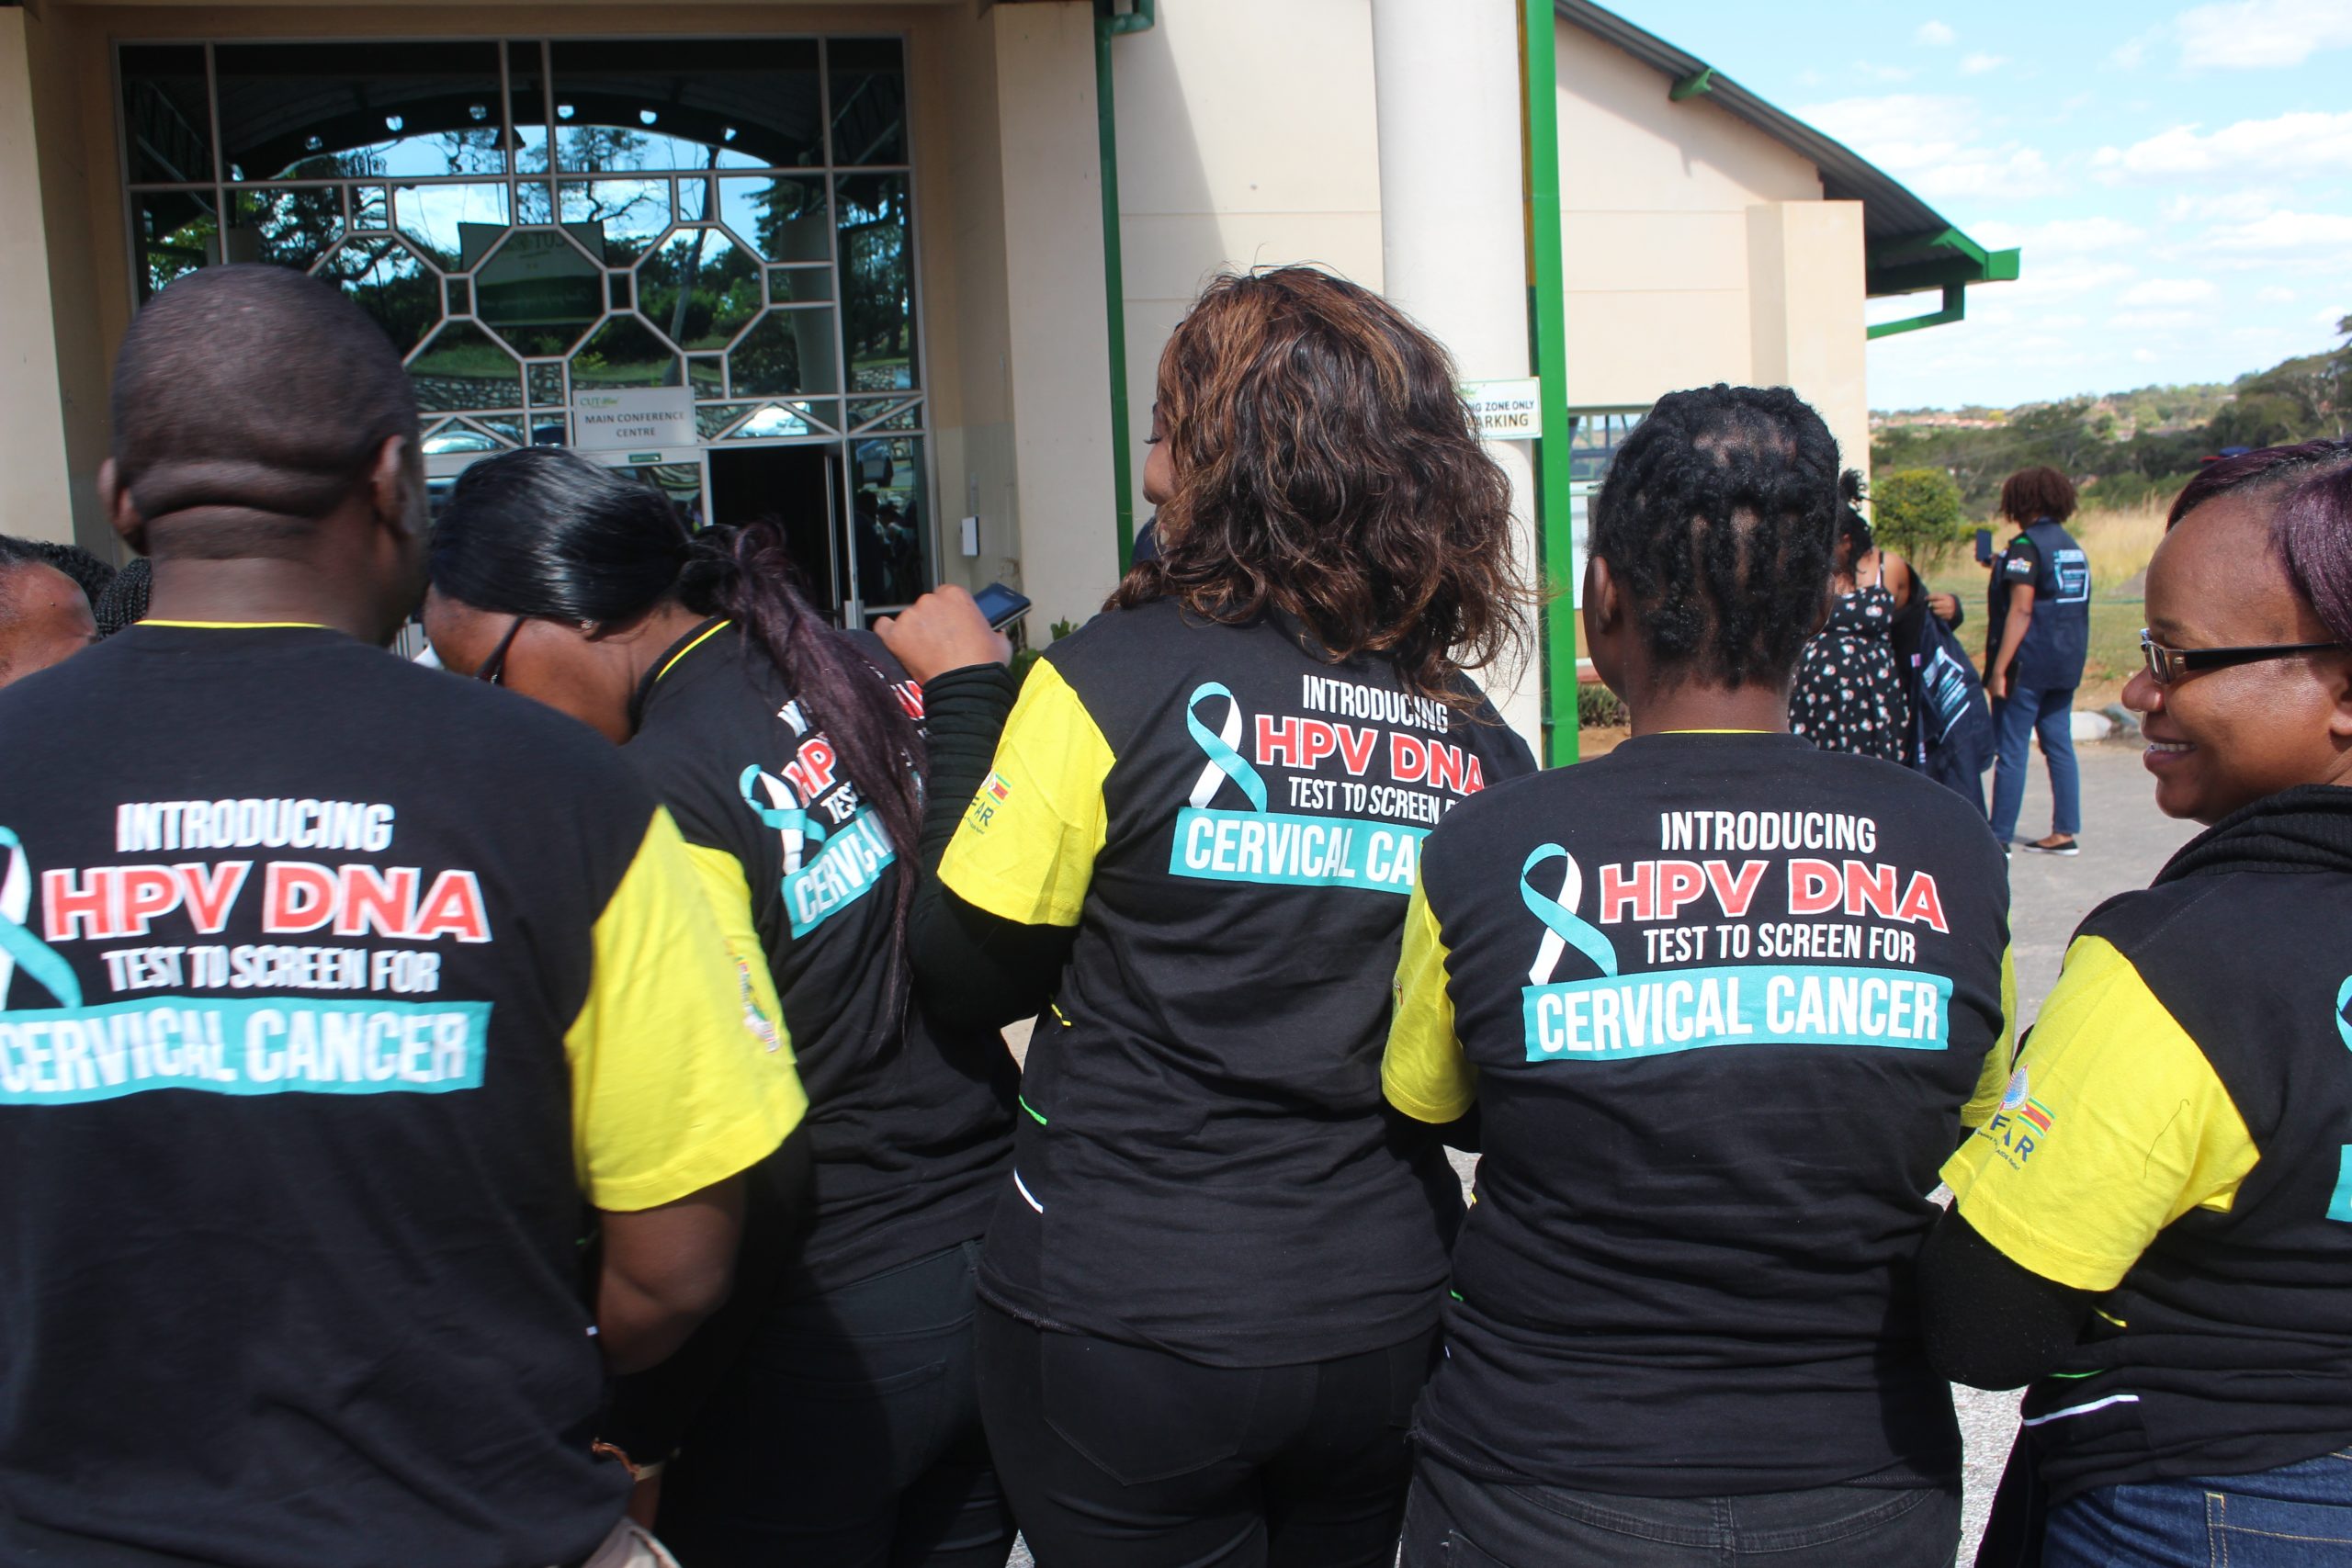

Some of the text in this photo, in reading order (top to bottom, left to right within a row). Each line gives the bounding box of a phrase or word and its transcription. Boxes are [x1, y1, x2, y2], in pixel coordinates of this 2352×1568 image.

[585, 412, 684, 423] MAIN CONFERENCE
[616, 427, 655, 437] CENTRE
[1468, 413, 1529, 428] ARKING
[1485, 401, 1510, 412] ZONE
[1512, 400, 1534, 410] ONLY
[1303, 674, 1449, 734] INTRODUCING
[781, 732, 837, 809] HP
[1255, 714, 1485, 796] HPV DNA
[116, 797, 395, 853] INTRODUCING
[820, 781, 858, 824] TES
[1288, 776, 1337, 810] TEST
[1341, 782, 1371, 813] TO
[1372, 785, 1440, 825] SCREEN
[1185, 817, 1355, 878] CERVICAL
[1661, 811, 1877, 853] INTRODUCING
[41, 859, 492, 943] HPV DNA
[1600, 858, 1950, 934] HPV DNA
[101, 943, 442, 993] TEST TO SCREEN FOR
[1643, 923, 1916, 964] TEST TO SCREEN FOR
[1536, 975, 1938, 1054] CERVICAL CANCER
[0, 1006, 469, 1094] CERVICAL CANCER
